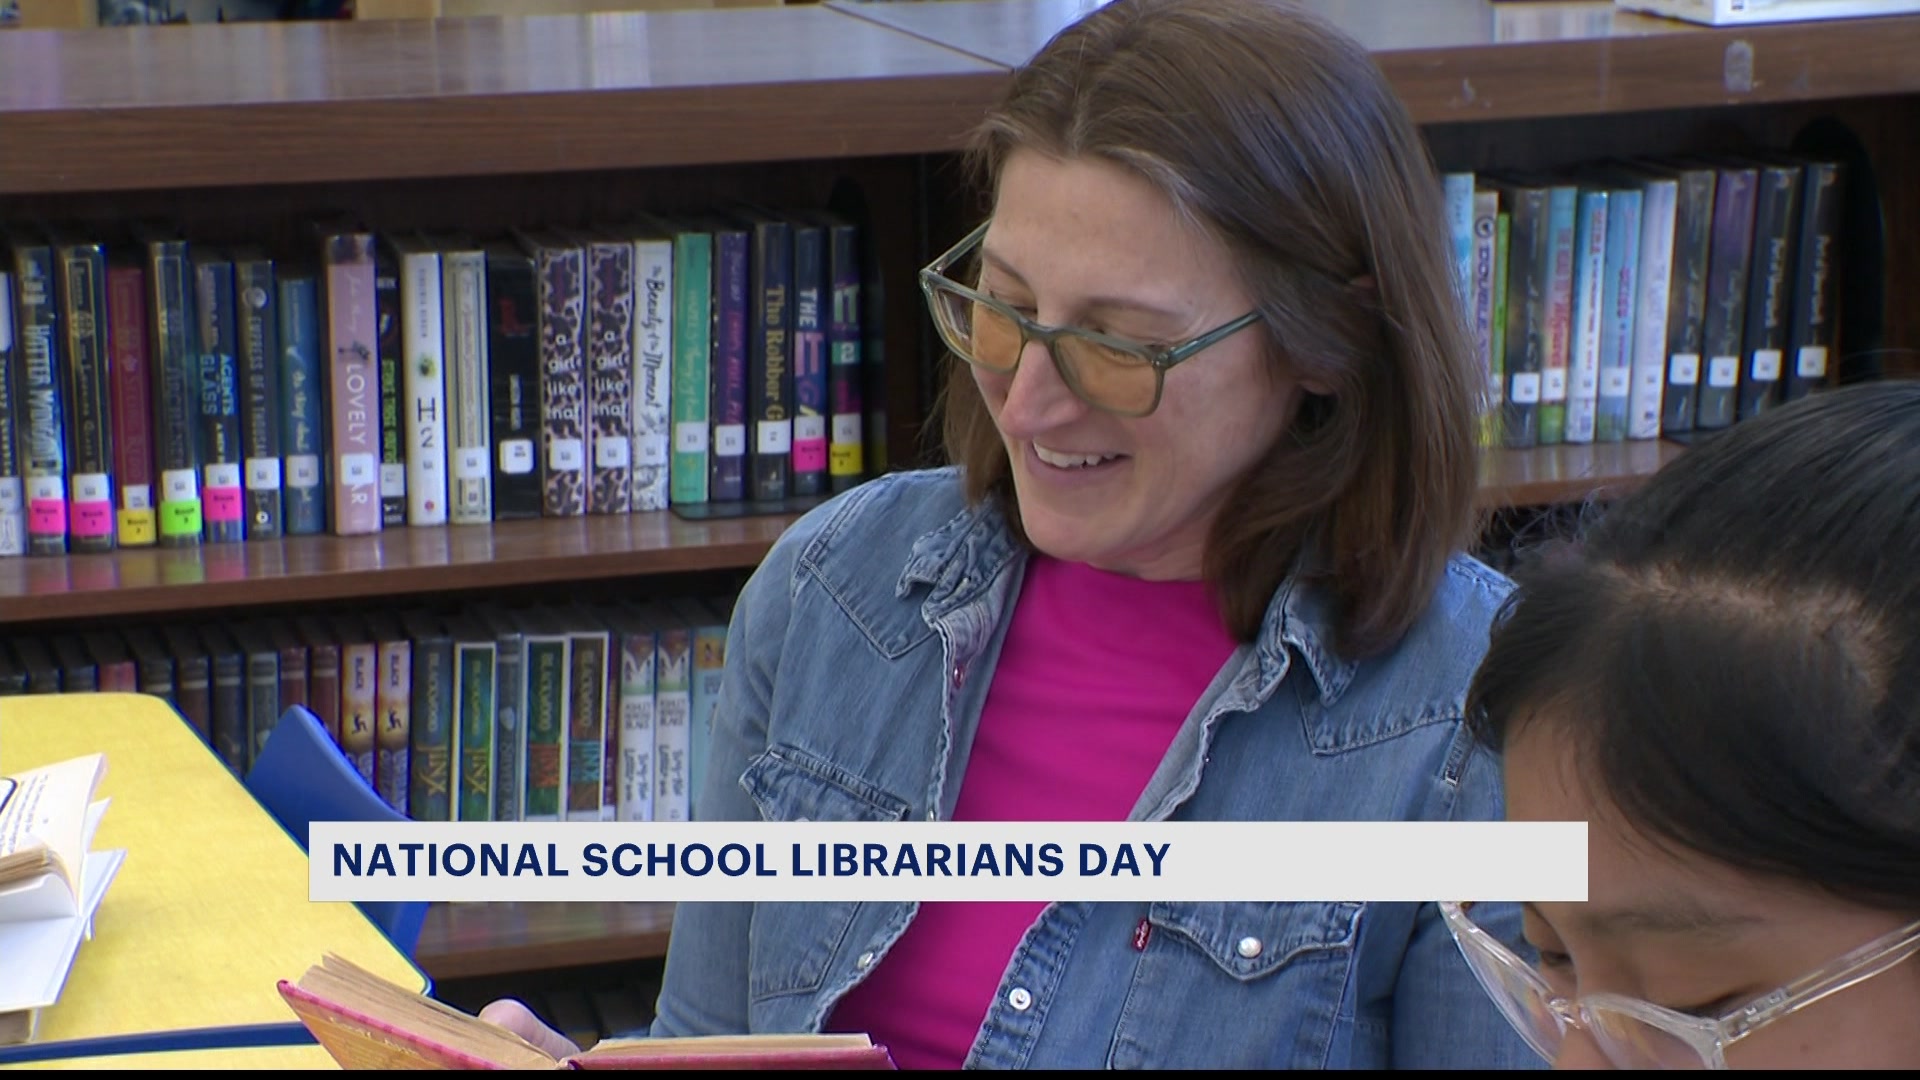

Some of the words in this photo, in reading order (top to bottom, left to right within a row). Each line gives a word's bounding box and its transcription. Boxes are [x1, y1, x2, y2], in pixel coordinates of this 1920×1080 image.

[641, 278, 666, 330] Beauty
[766, 284, 785, 326] The
[799, 287, 818, 329] THE
[249, 316, 264, 369] EMPRESS
[556, 334, 567, 346] a
[604, 330, 615, 343] a
[200, 355, 217, 415] GLASS
[220, 354, 236, 416] AGENTS
[643, 351, 664, 410] Moment
[766, 328, 785, 401] Robber
[346, 362, 367, 445] LOVELY
[252, 406, 268, 457] THOUSAN
[354, 656, 365, 691] BLACK
[391, 654, 400, 687] BLACK
[426, 652, 441, 733] BLACKWOOD
[539, 652, 553, 732] BLACKWOOD
[416, 741, 448, 796] JINX
[465, 747, 487, 796] JINX
